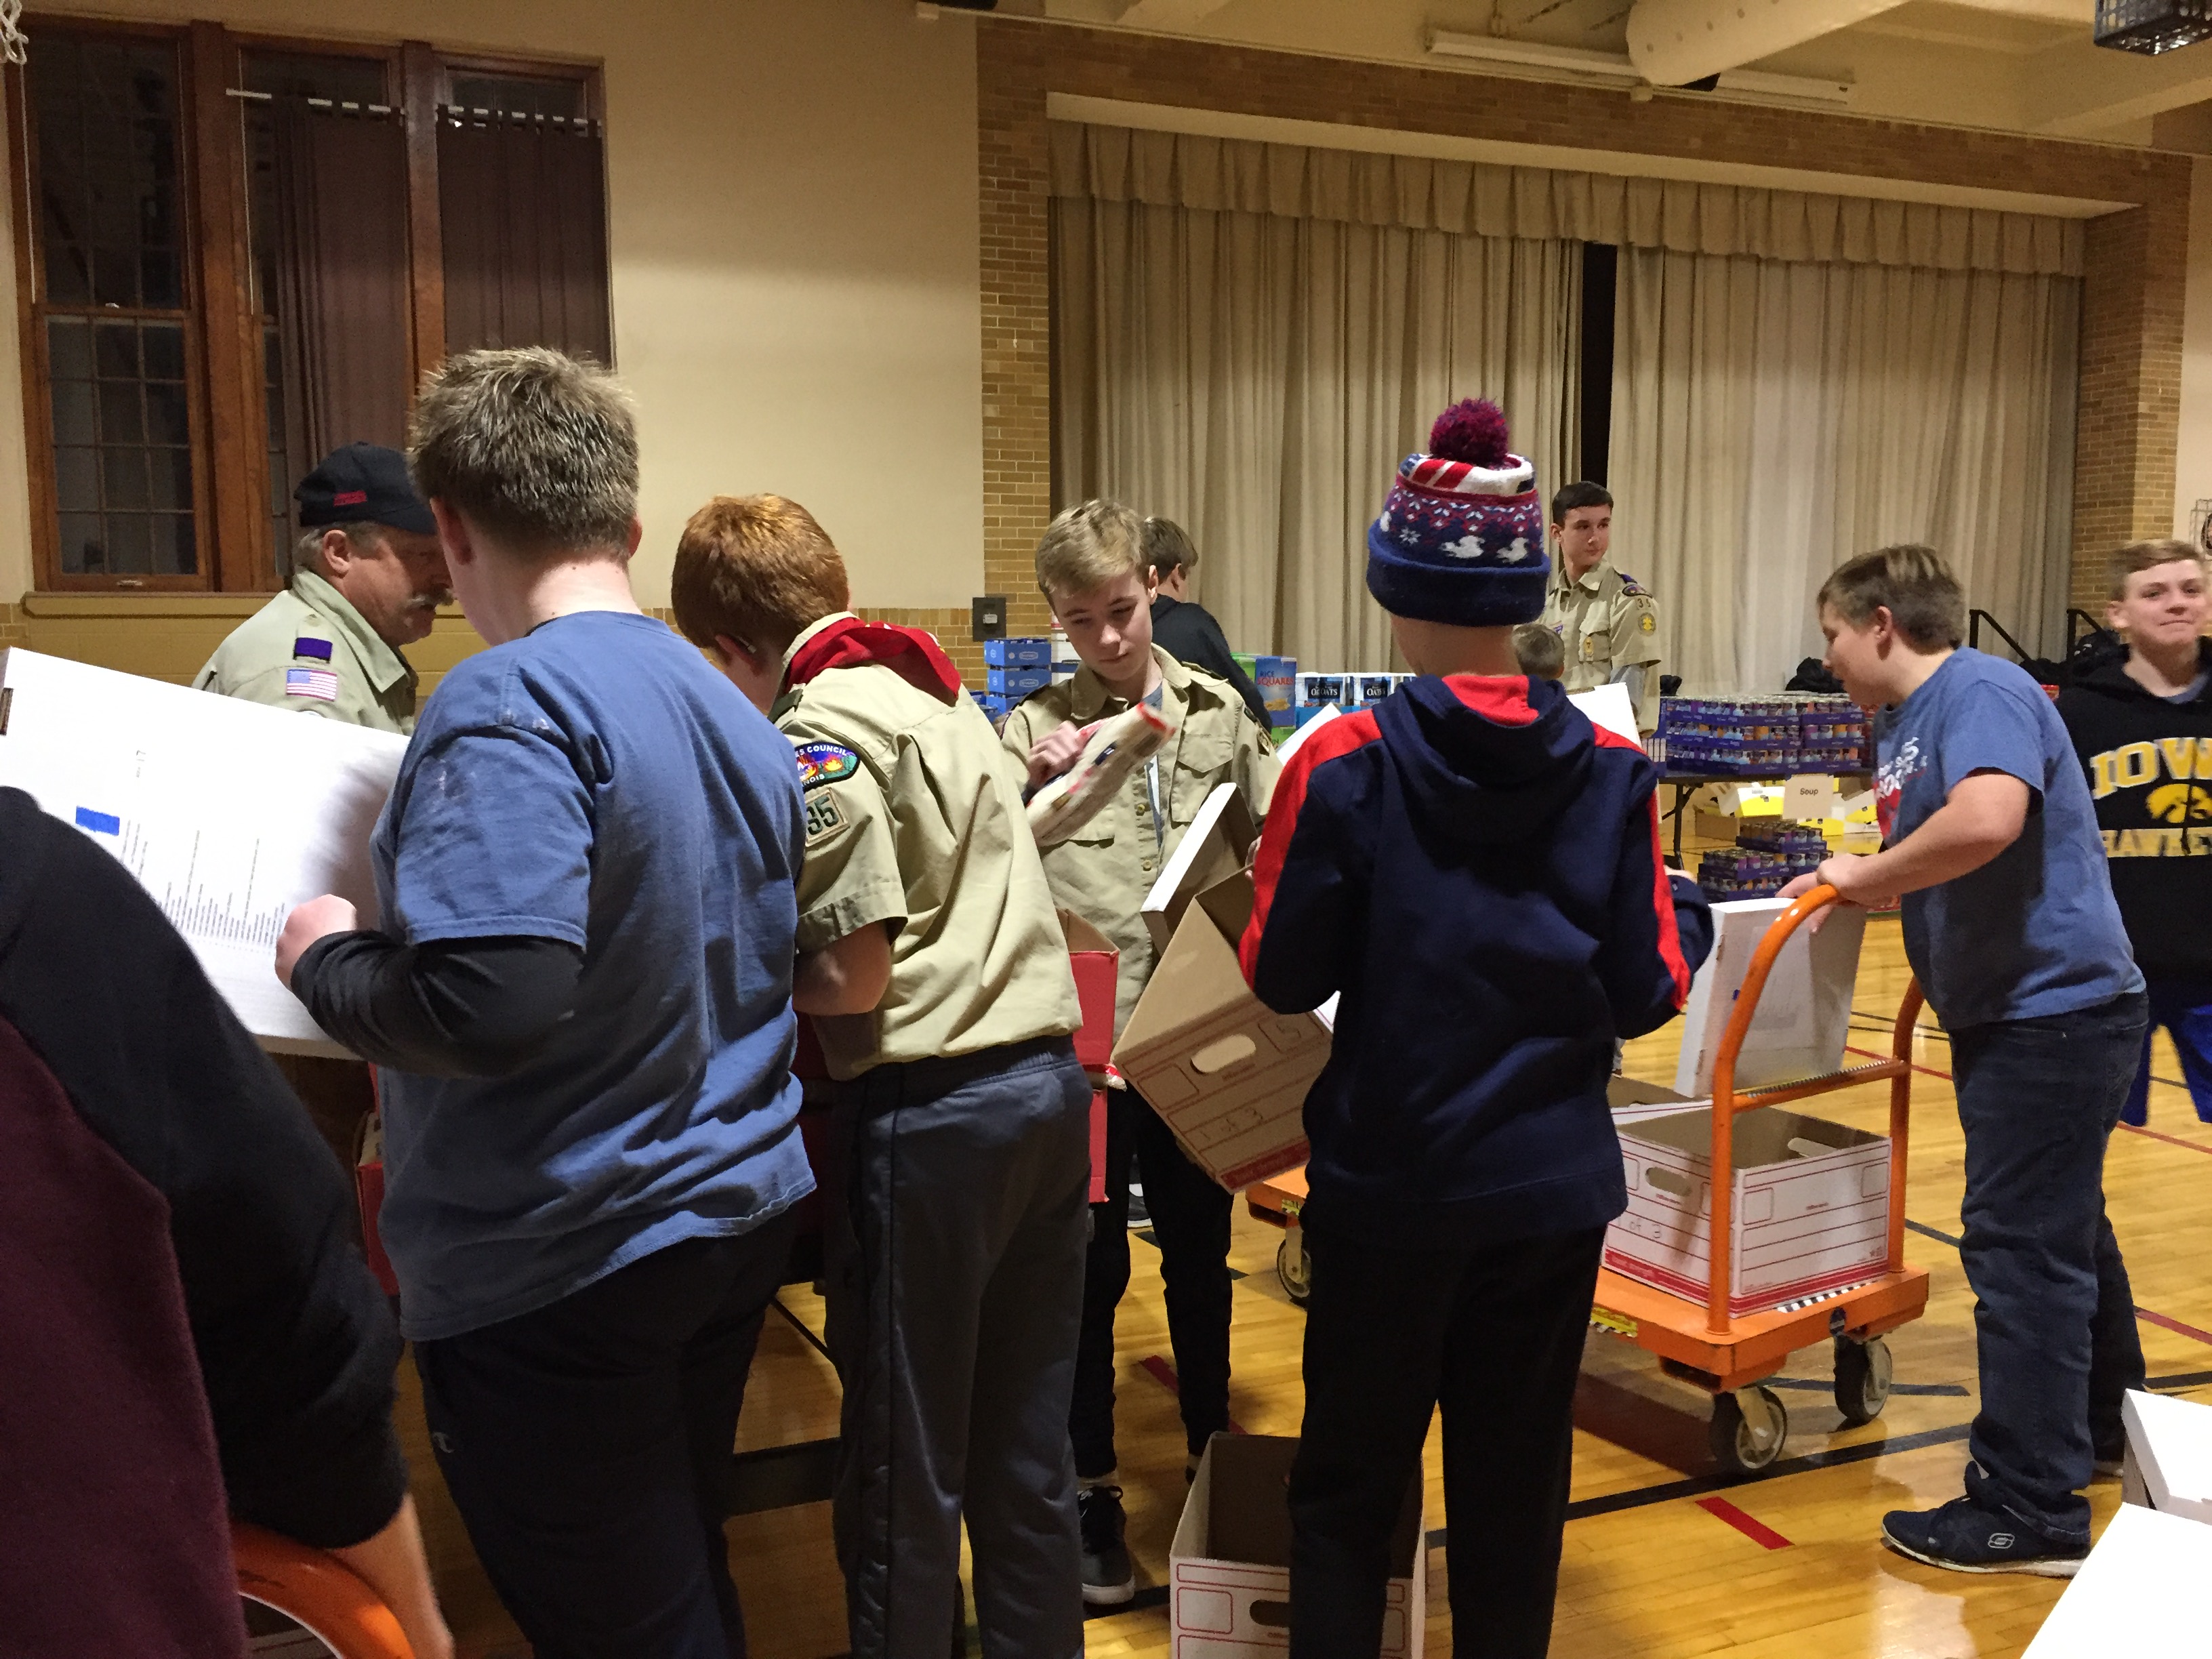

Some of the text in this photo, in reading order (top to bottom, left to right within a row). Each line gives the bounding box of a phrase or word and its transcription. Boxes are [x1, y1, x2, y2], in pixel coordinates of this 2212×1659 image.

[1258, 678, 1294, 687] SQUARES
[807, 745, 846, 756] COUNCIL
[1800, 787, 1818, 796] Soup
